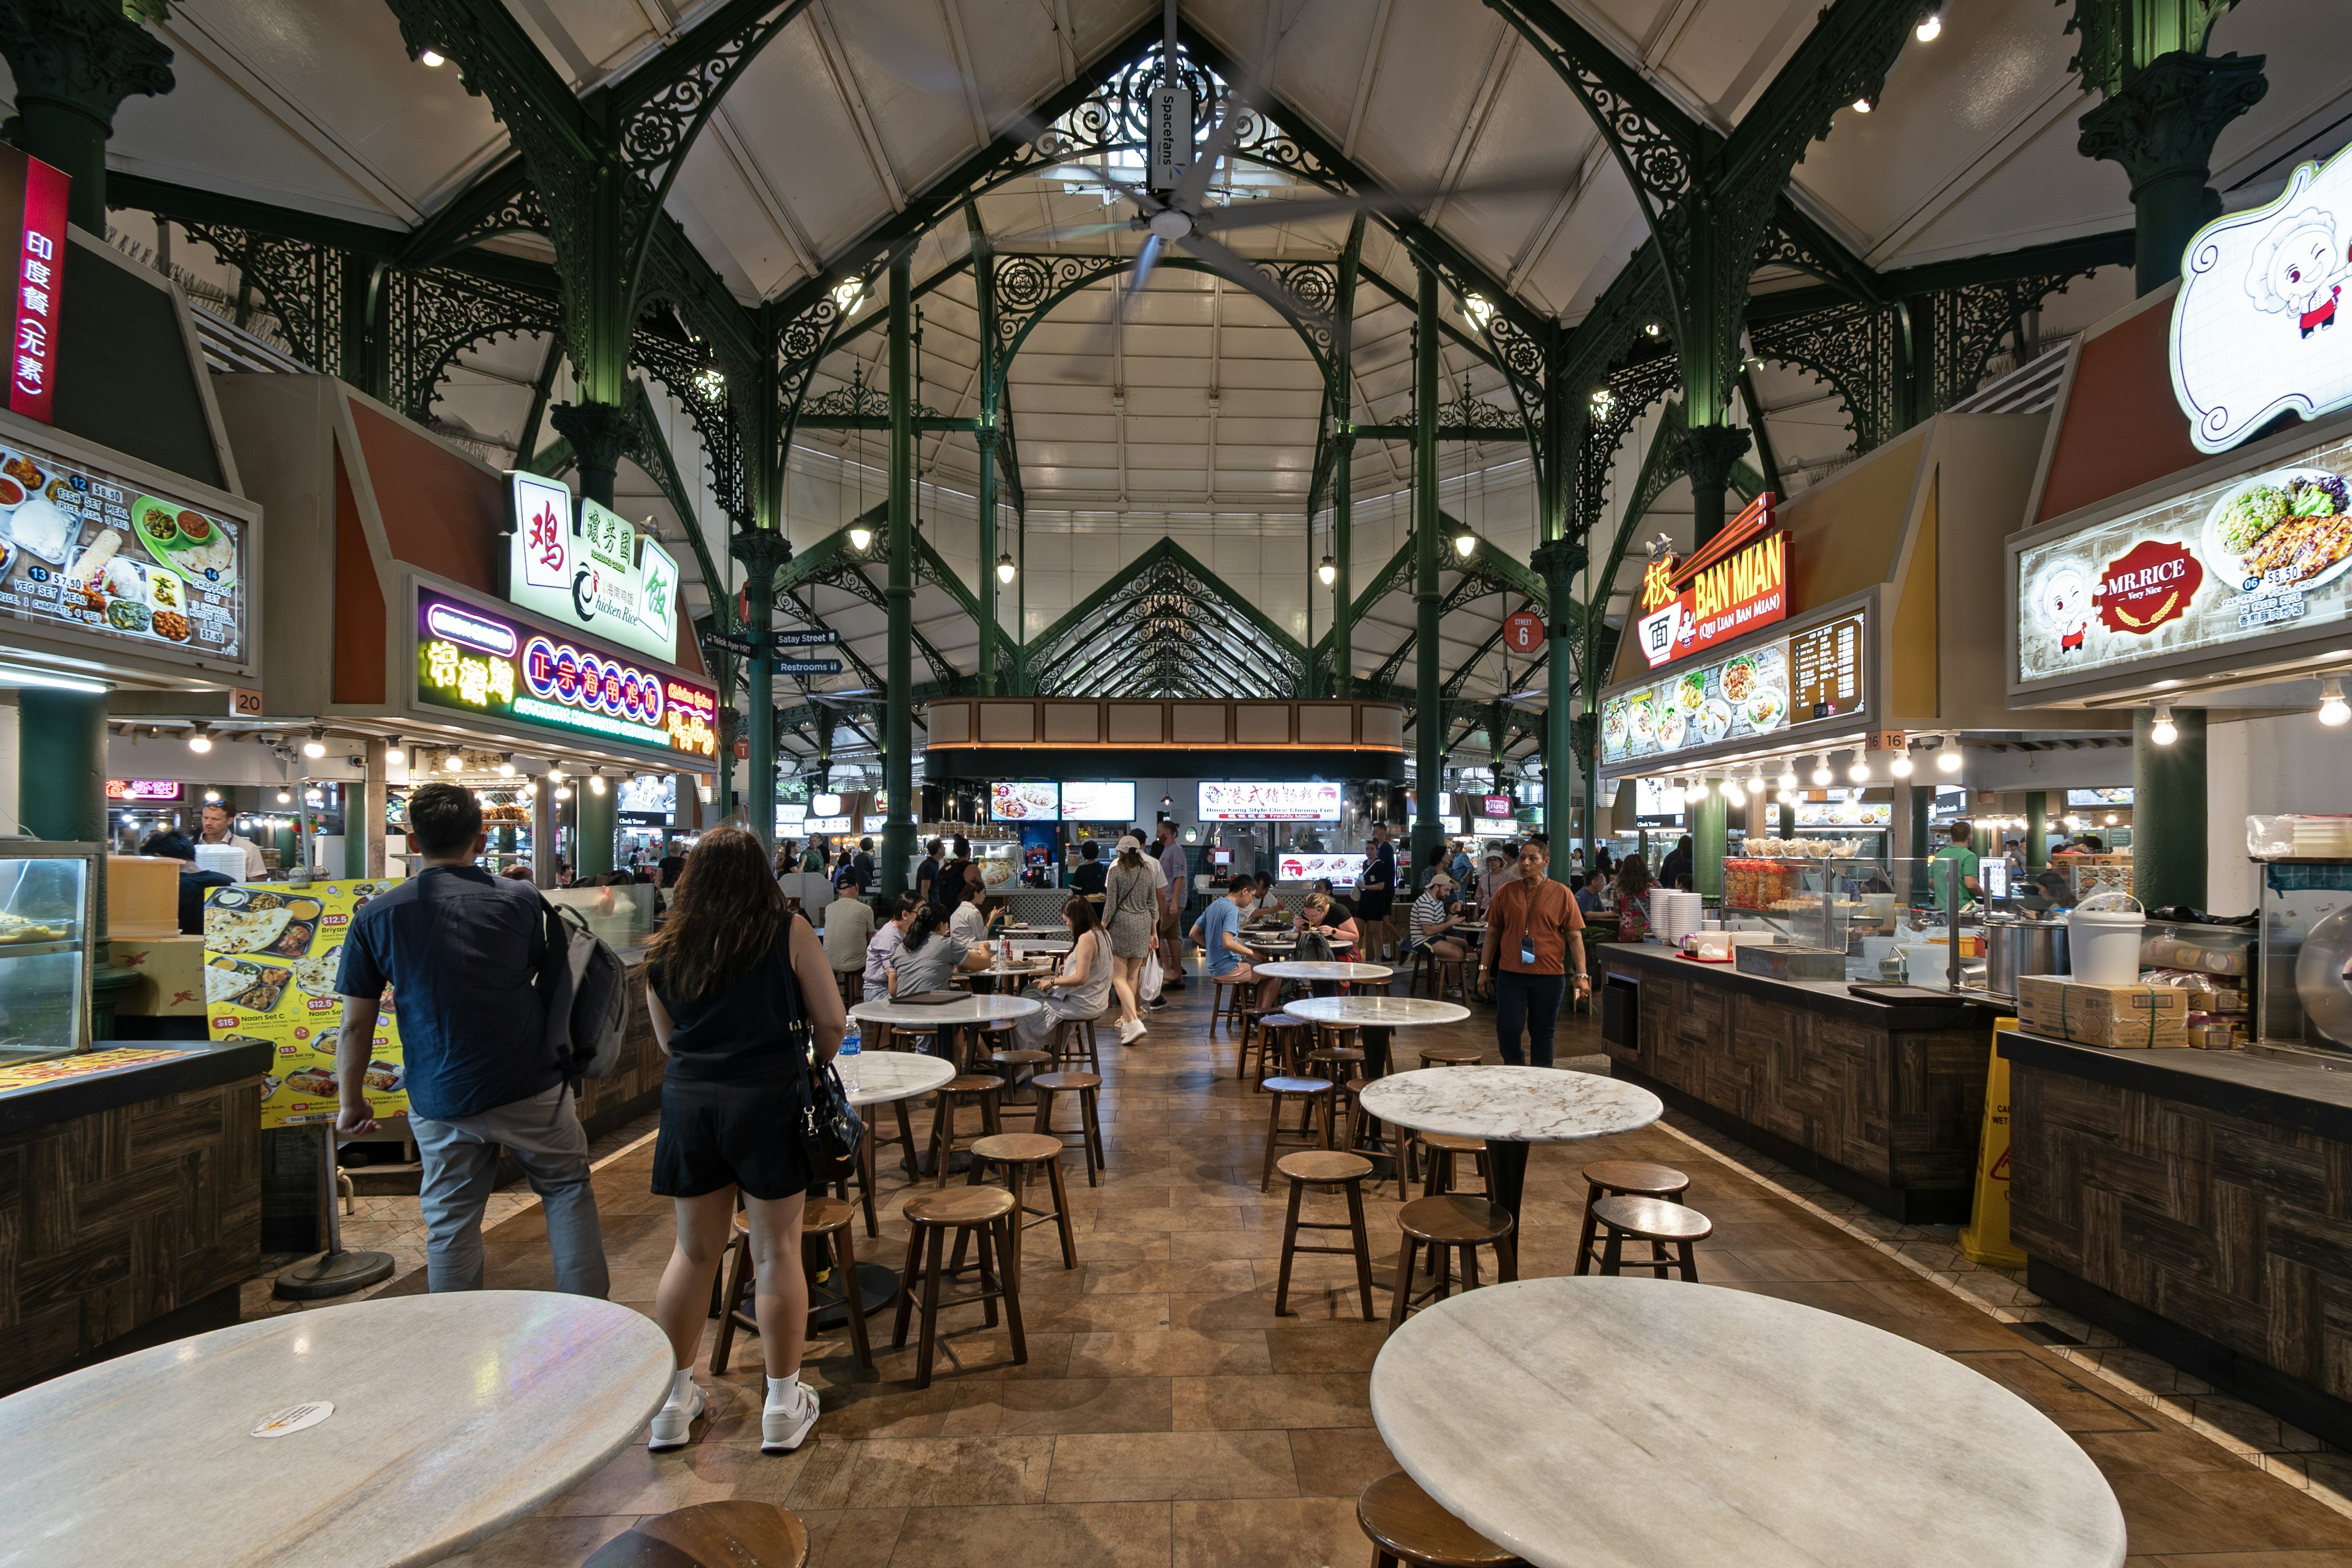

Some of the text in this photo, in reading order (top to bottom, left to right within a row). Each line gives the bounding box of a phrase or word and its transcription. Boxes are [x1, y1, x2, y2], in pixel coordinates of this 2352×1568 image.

[1161, 95, 1174, 165] Spacefans
[73, 477, 86, 490] 12
[57, 489, 129, 519] FISH SET MEAL
[528, 501, 564, 571] 鸡
[31, 568, 46, 580] 13
[207, 569, 218, 580] 14
[1695, 532, 1781, 622] BAN MIAN
[2244, 566, 2298, 590] 06 $8.50
[15, 580, 87, 606] VEG SET MEAL
[193, 580, 231, 597] CHAPPATI
[645, 564, 667, 626] 饭
[2128, 585, 2163, 600] Very Nice
[205, 593, 220, 604] SET
[2280, 593, 2301, 604] RICE
[622, 606, 638, 625] Rice
[1716, 613, 1735, 632] LIAN
[1736, 607, 1752, 624] BAN
[1753, 592, 1781, 617] MIAN)
[778, 633, 826, 645] Satay Street
[1519, 627, 1528, 646] 6
[713, 635, 750, 654] Telok Ayer MRT
[780, 662, 828, 671] Restrooms
[531, 651, 657, 715] 正宗海南鸡饭
[239, 694, 260, 711] 20
[1869, 735, 1879, 748] 16
[1886, 735, 1901, 746] 16
[740, 748, 745, 756] 1
[322, 916, 347, 924] $12.5
[308, 999, 333, 1008] $12.5
[218, 1018, 234, 1027] $15
[1992, 1116, 2009, 1125] WET
